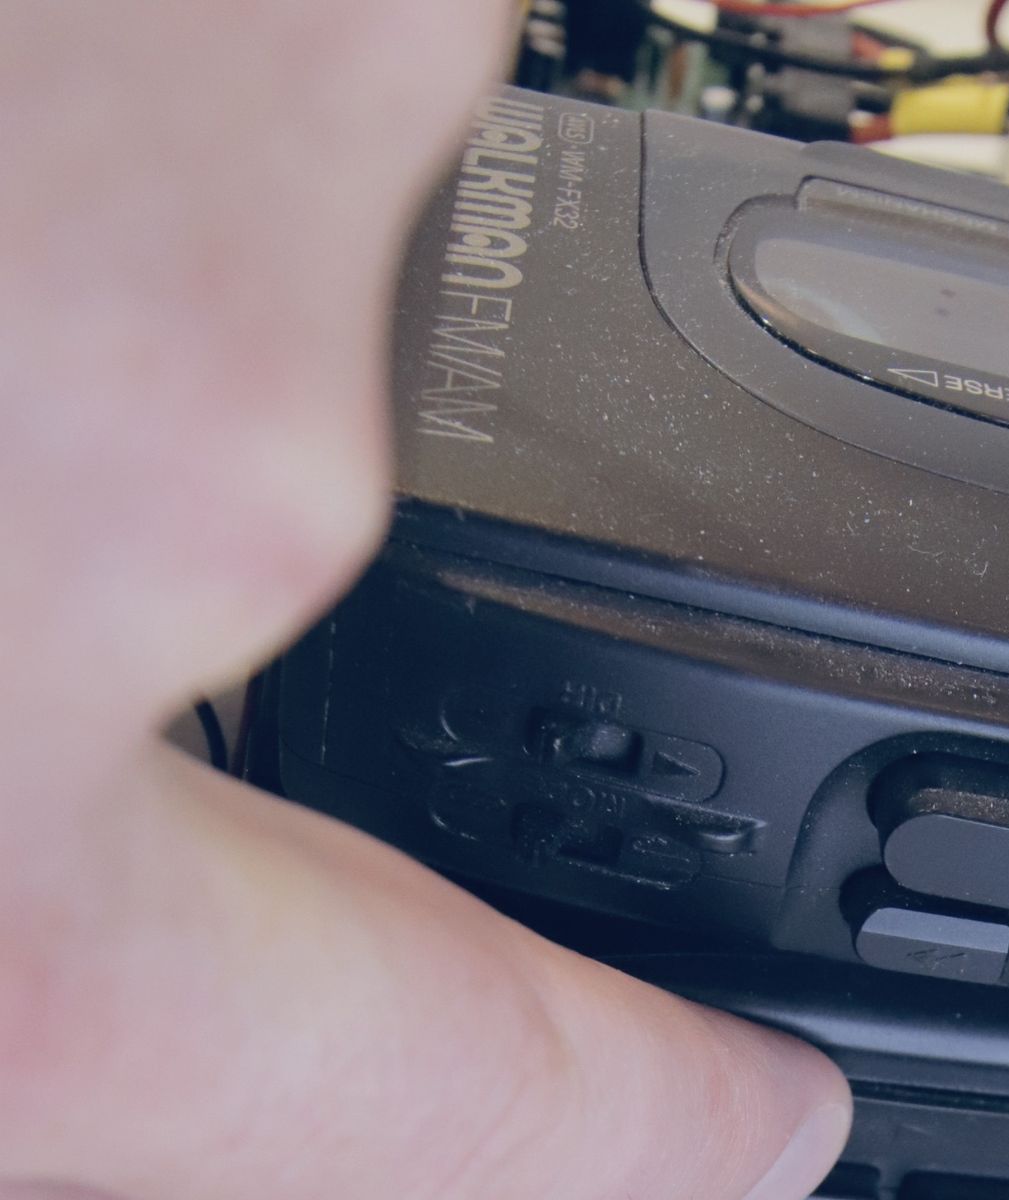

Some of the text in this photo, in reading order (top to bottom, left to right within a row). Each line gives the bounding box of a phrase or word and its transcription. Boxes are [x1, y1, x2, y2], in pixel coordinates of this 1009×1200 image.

[416, 96, 544, 445] WALKMAN FM/AM
[553, 149, 585, 230] WM-FX32
